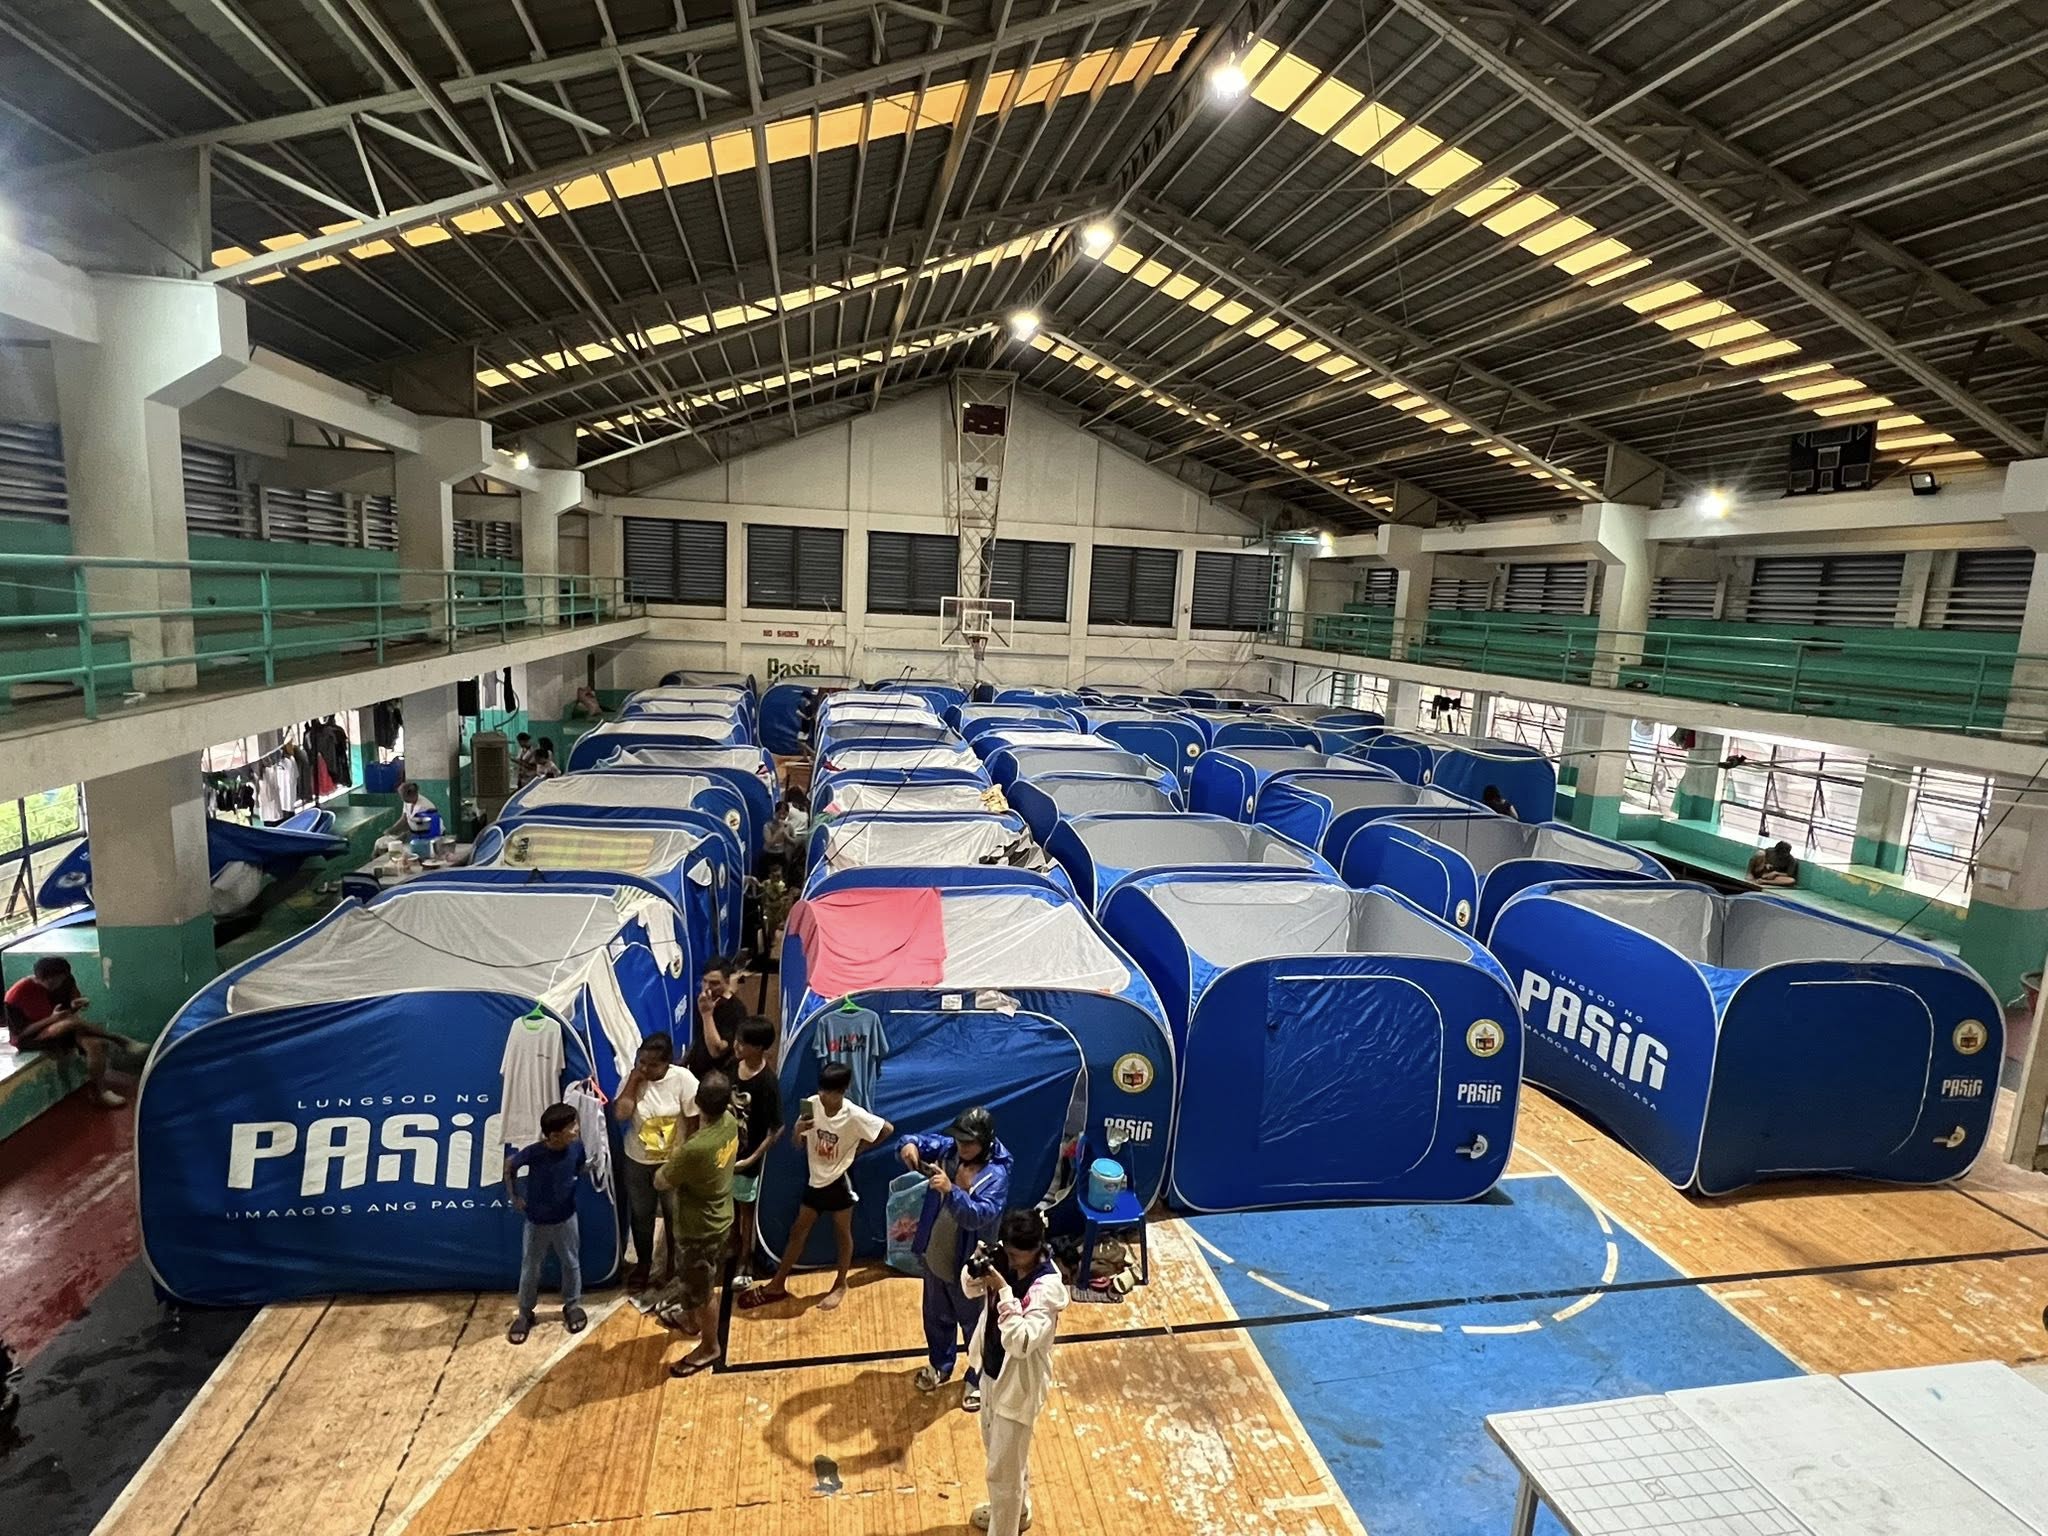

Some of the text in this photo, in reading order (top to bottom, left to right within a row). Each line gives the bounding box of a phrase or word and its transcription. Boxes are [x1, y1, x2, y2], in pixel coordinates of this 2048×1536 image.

[777, 630, 799, 638] SHOES
[1551, 969, 1644, 1023] LUNGSOD NG
[1523, 1022, 1658, 1111] MAAGOS ANG PAG-ASA
[297, 1093, 489, 1109] LUNGSOD NG
[367, 1200, 417, 1213] ANG
